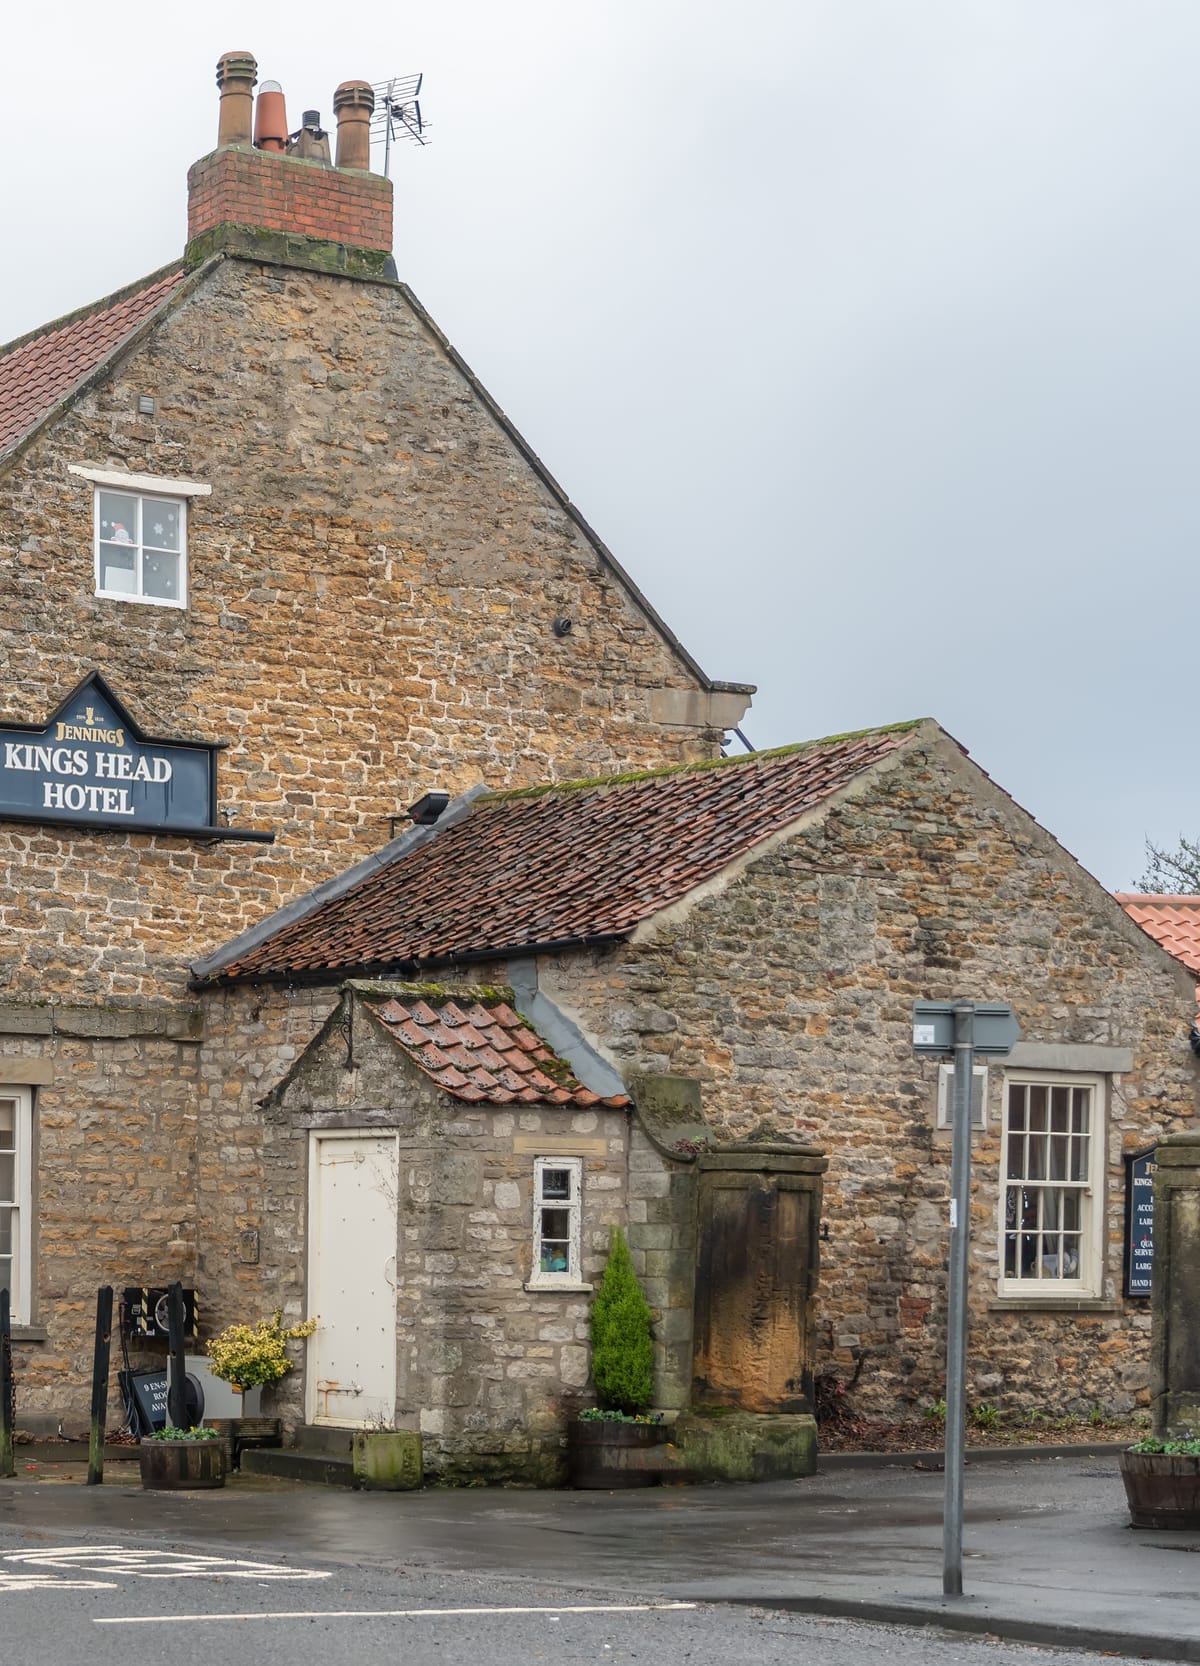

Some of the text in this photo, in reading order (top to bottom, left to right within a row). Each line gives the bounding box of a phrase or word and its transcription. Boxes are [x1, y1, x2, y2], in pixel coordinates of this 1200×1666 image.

[55, 722, 125, 747] JENNINGS
[4, 743, 173, 783] KINGS HEAD
[43, 782, 135, 815] HOTEL
[153, 1391, 168, 1400] ROO
